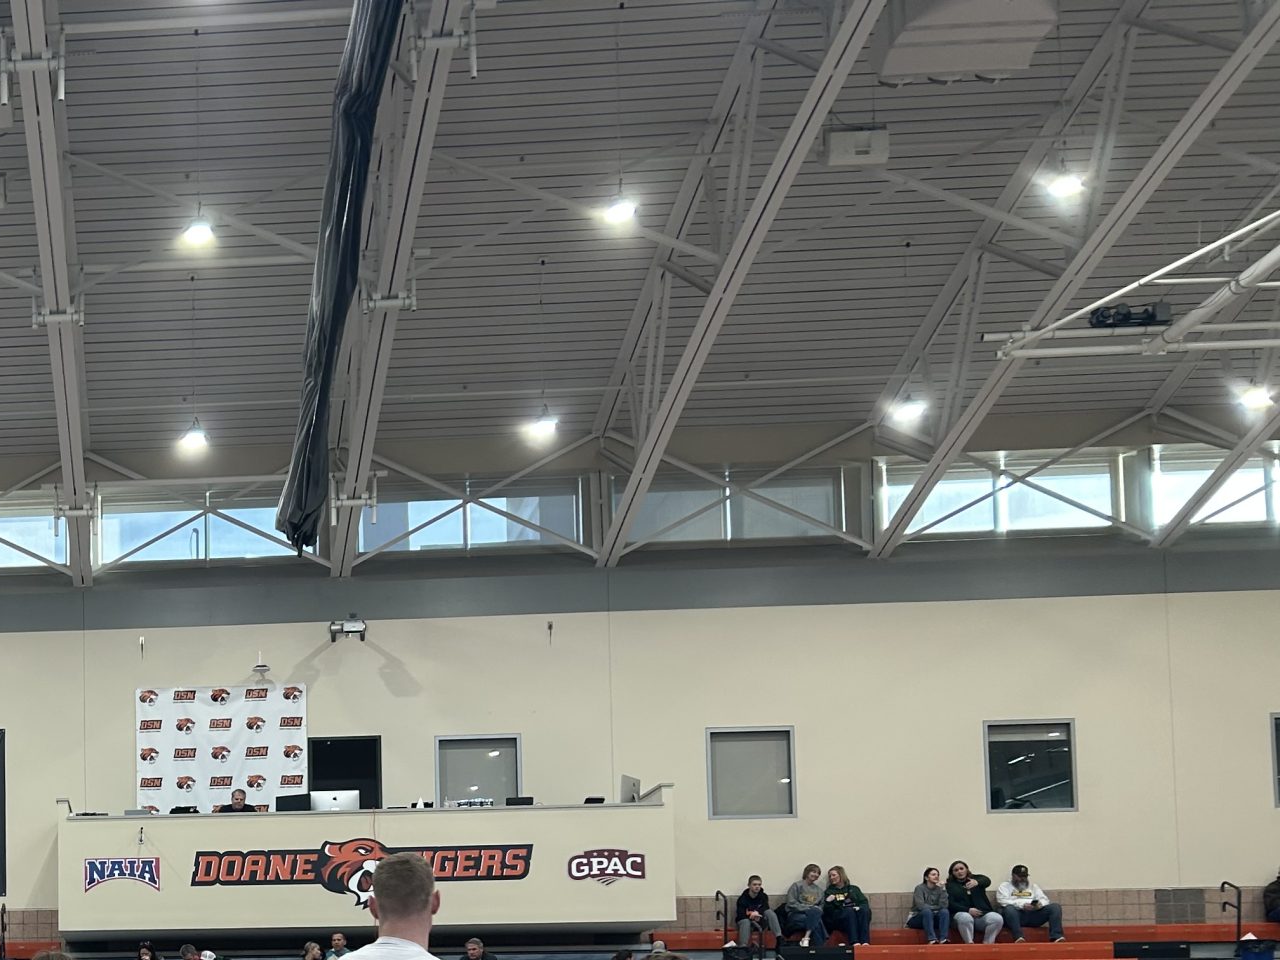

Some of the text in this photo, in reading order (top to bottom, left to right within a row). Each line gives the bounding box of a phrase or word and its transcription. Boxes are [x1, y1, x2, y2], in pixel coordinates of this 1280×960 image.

[174, 691, 195, 700] DSN
[246, 689, 267, 698] DSN
[140, 721, 161, 729] DSN
[210, 719, 231, 728] DSN
[281, 718, 302, 726] DSN
[174, 749, 196, 758] DSN
[246, 747, 268, 756] DSN
[141, 779, 162, 787] DSN
[210, 777, 232, 786] DSN
[281, 776, 302, 784] DSN
[195, 854, 319, 881] DOANE
[570, 857, 642, 878] GPAC
[86, 859, 158, 888] NAIA
